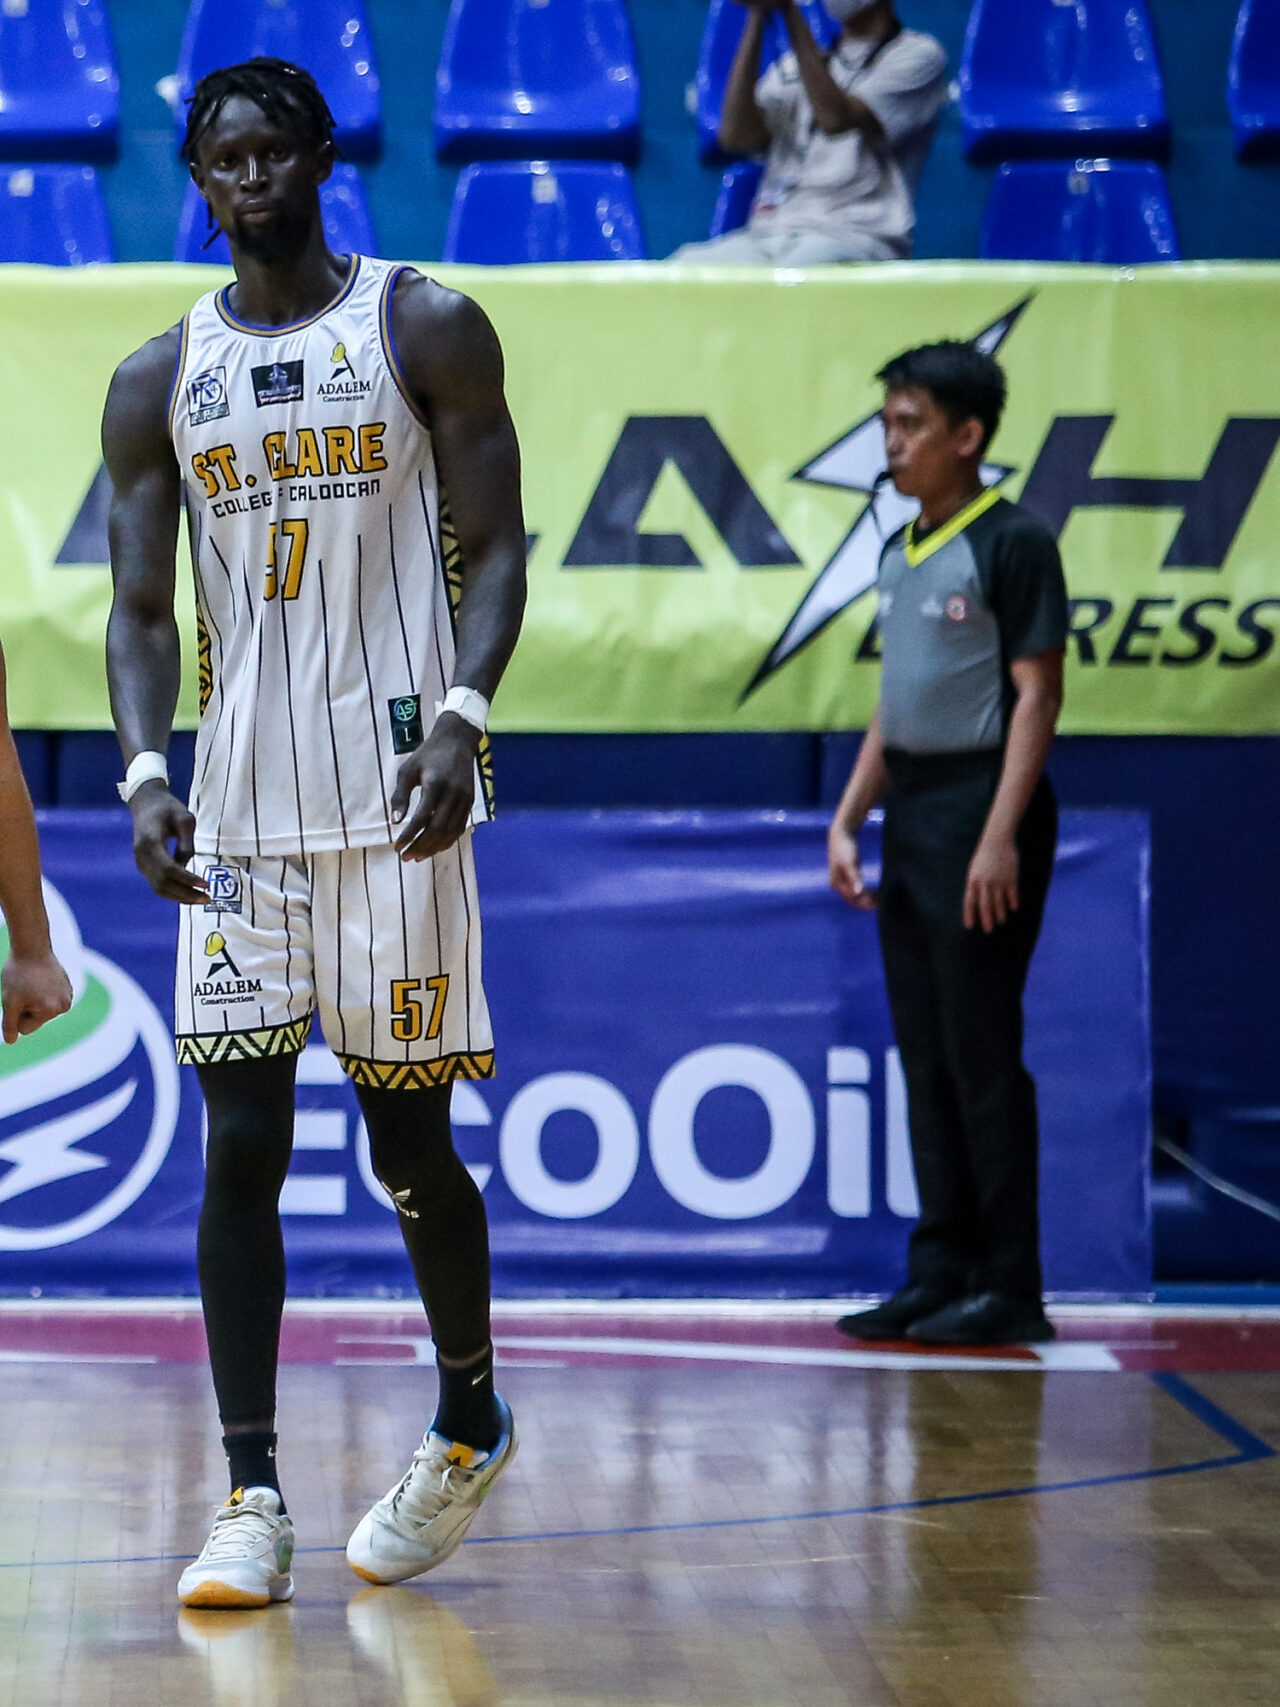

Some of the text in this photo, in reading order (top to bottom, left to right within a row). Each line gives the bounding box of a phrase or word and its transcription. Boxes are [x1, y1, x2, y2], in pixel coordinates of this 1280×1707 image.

[317, 380, 371, 395] ADALEM
[290, 478, 380, 501] CALOOCAN
[194, 979, 262, 996] ADALEM
[200, 995, 255, 1005] Construction
[391, 973, 450, 1041] 57
